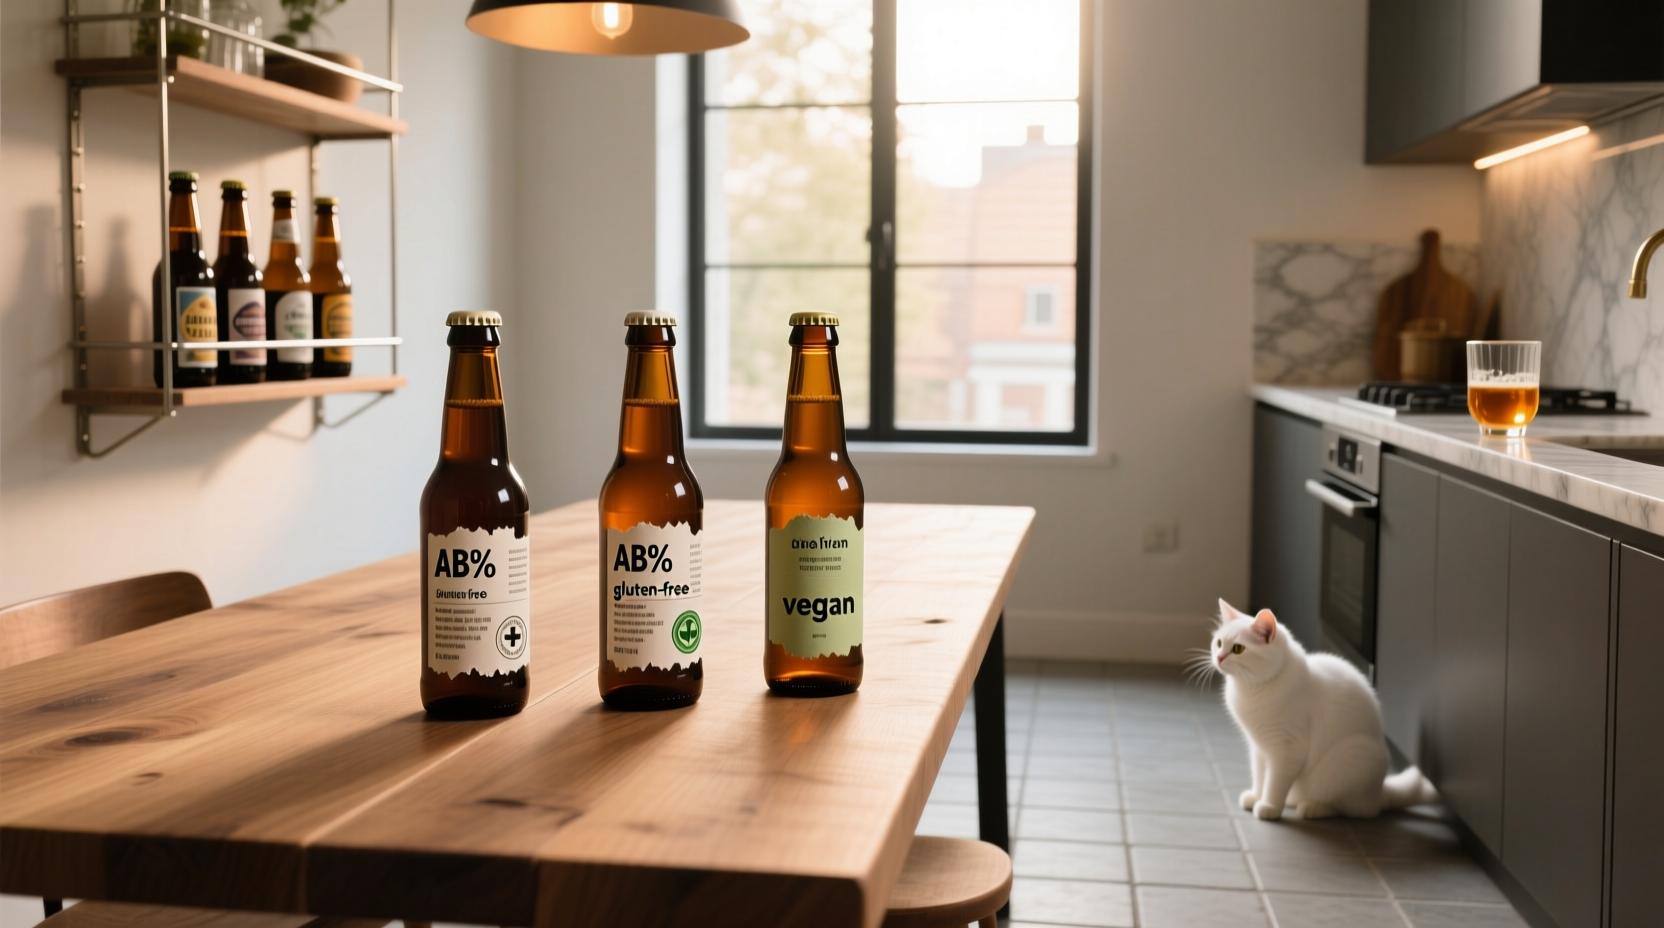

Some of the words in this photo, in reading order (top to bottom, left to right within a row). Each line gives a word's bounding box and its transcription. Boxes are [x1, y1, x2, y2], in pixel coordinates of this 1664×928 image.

[434, 548, 496, 579] AB%
[613, 543, 673, 573] AB%
[613, 580, 690, 601] gluten-free
[782, 595, 855, 623] vegan
